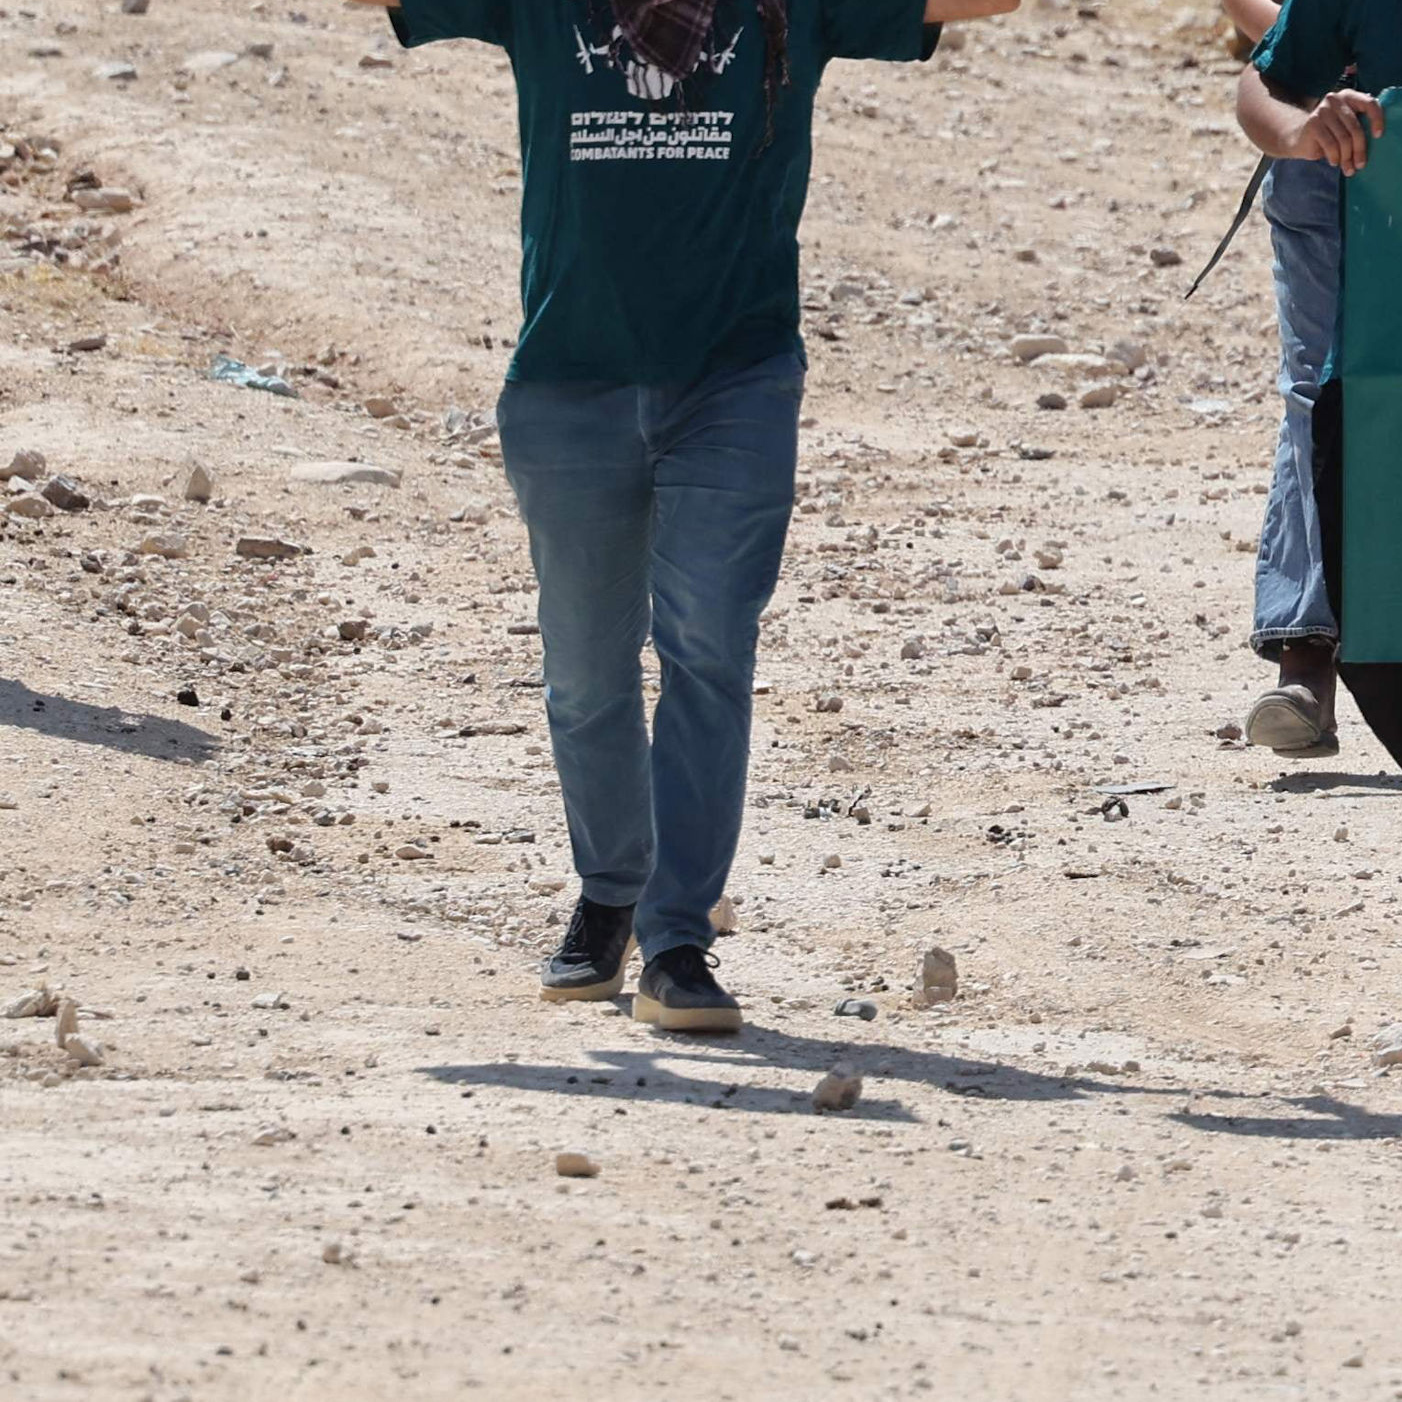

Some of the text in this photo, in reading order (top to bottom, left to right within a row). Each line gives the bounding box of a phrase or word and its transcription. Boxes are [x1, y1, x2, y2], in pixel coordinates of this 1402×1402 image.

[570, 110, 644, 126] לשלום
[570, 147, 730, 161] COMBATANTS FOR PEACE
